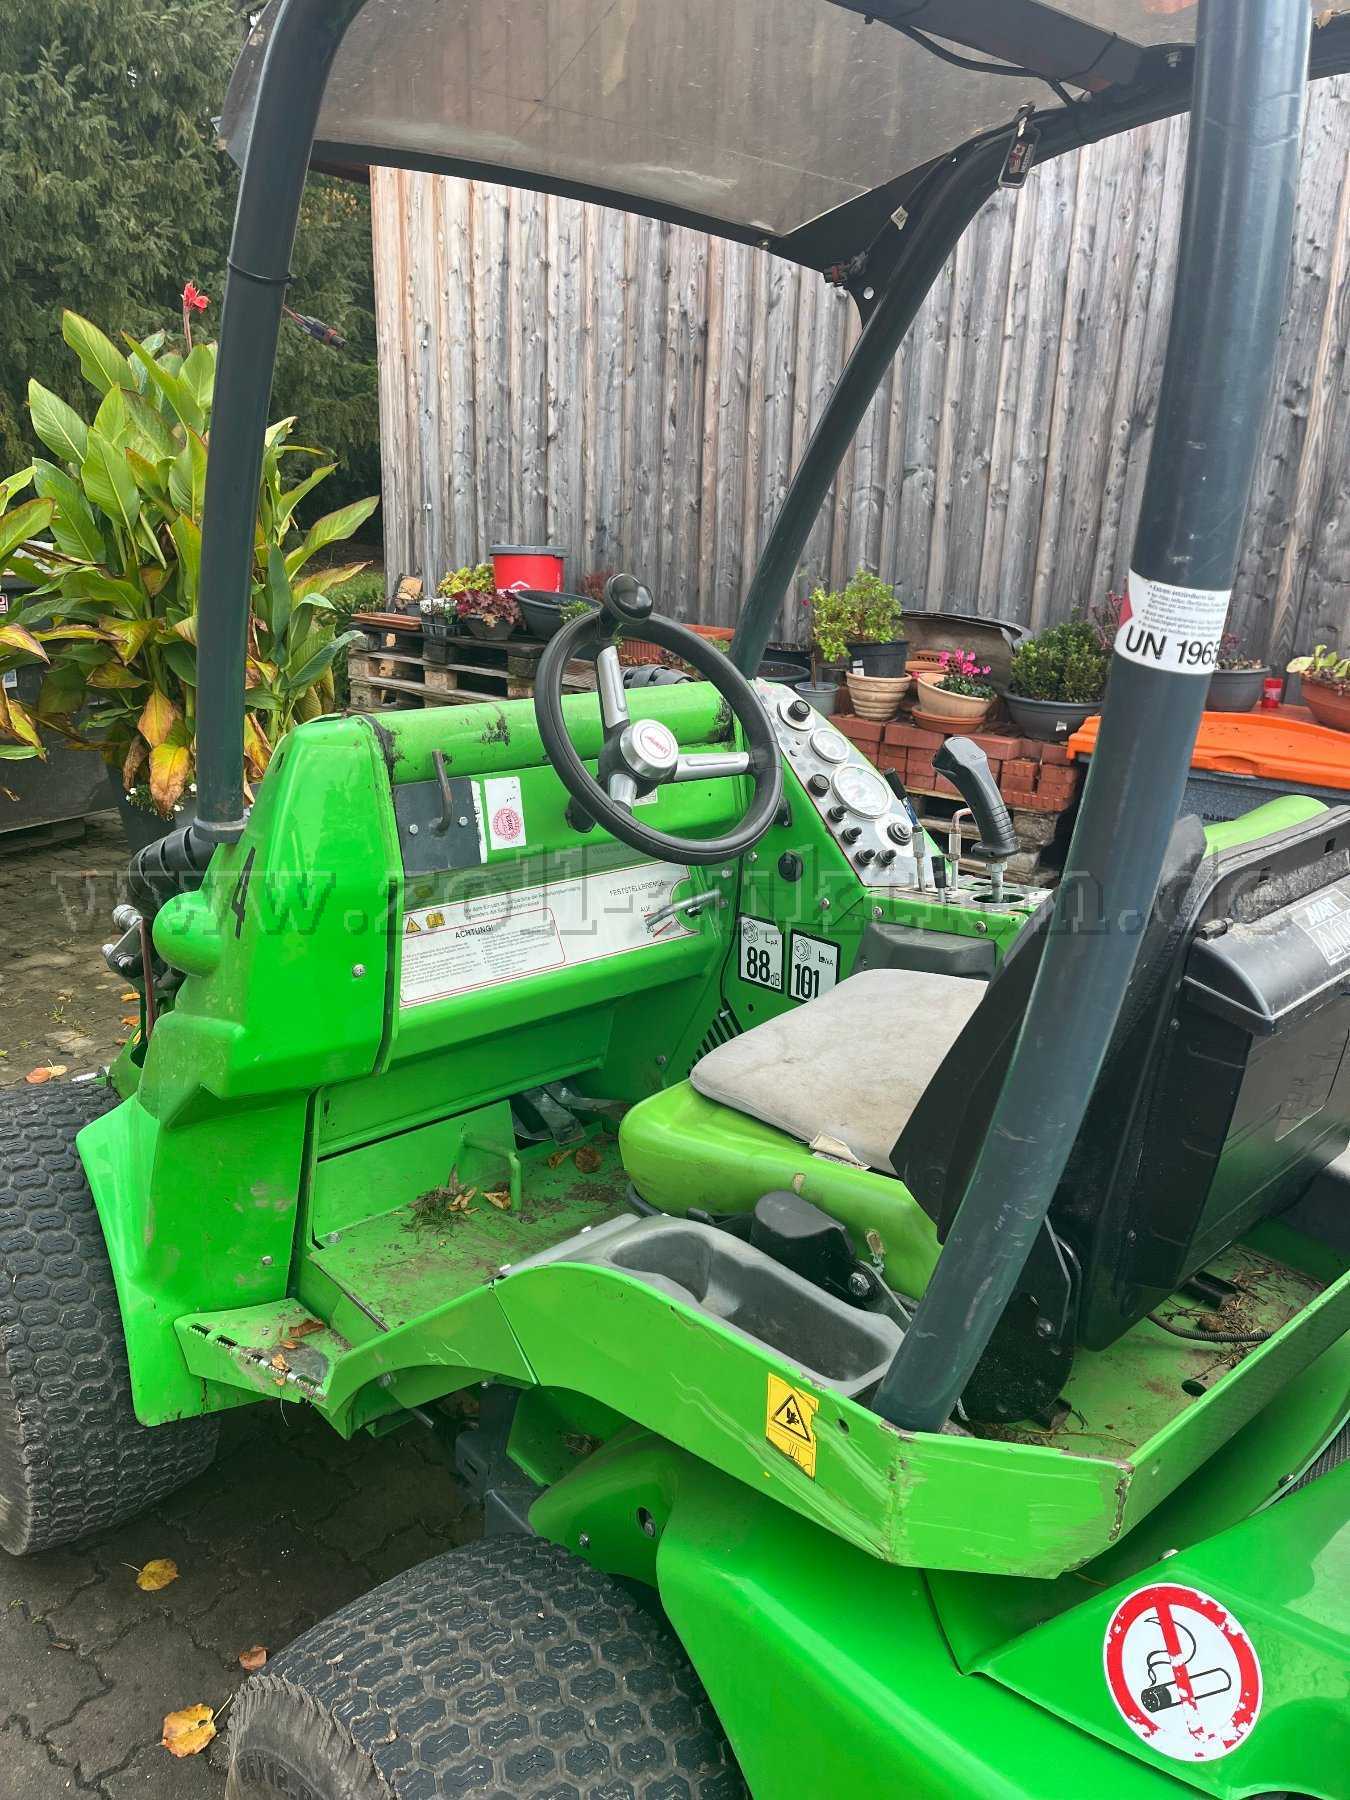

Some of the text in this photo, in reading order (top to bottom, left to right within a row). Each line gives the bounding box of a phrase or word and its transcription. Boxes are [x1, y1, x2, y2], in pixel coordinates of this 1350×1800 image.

[1125, 624, 1168, 660] UN
[455, 924, 494, 939] ACHTUNG!
[746, 946, 781, 987] 88 dB
[794, 963, 820, 1000] 101
